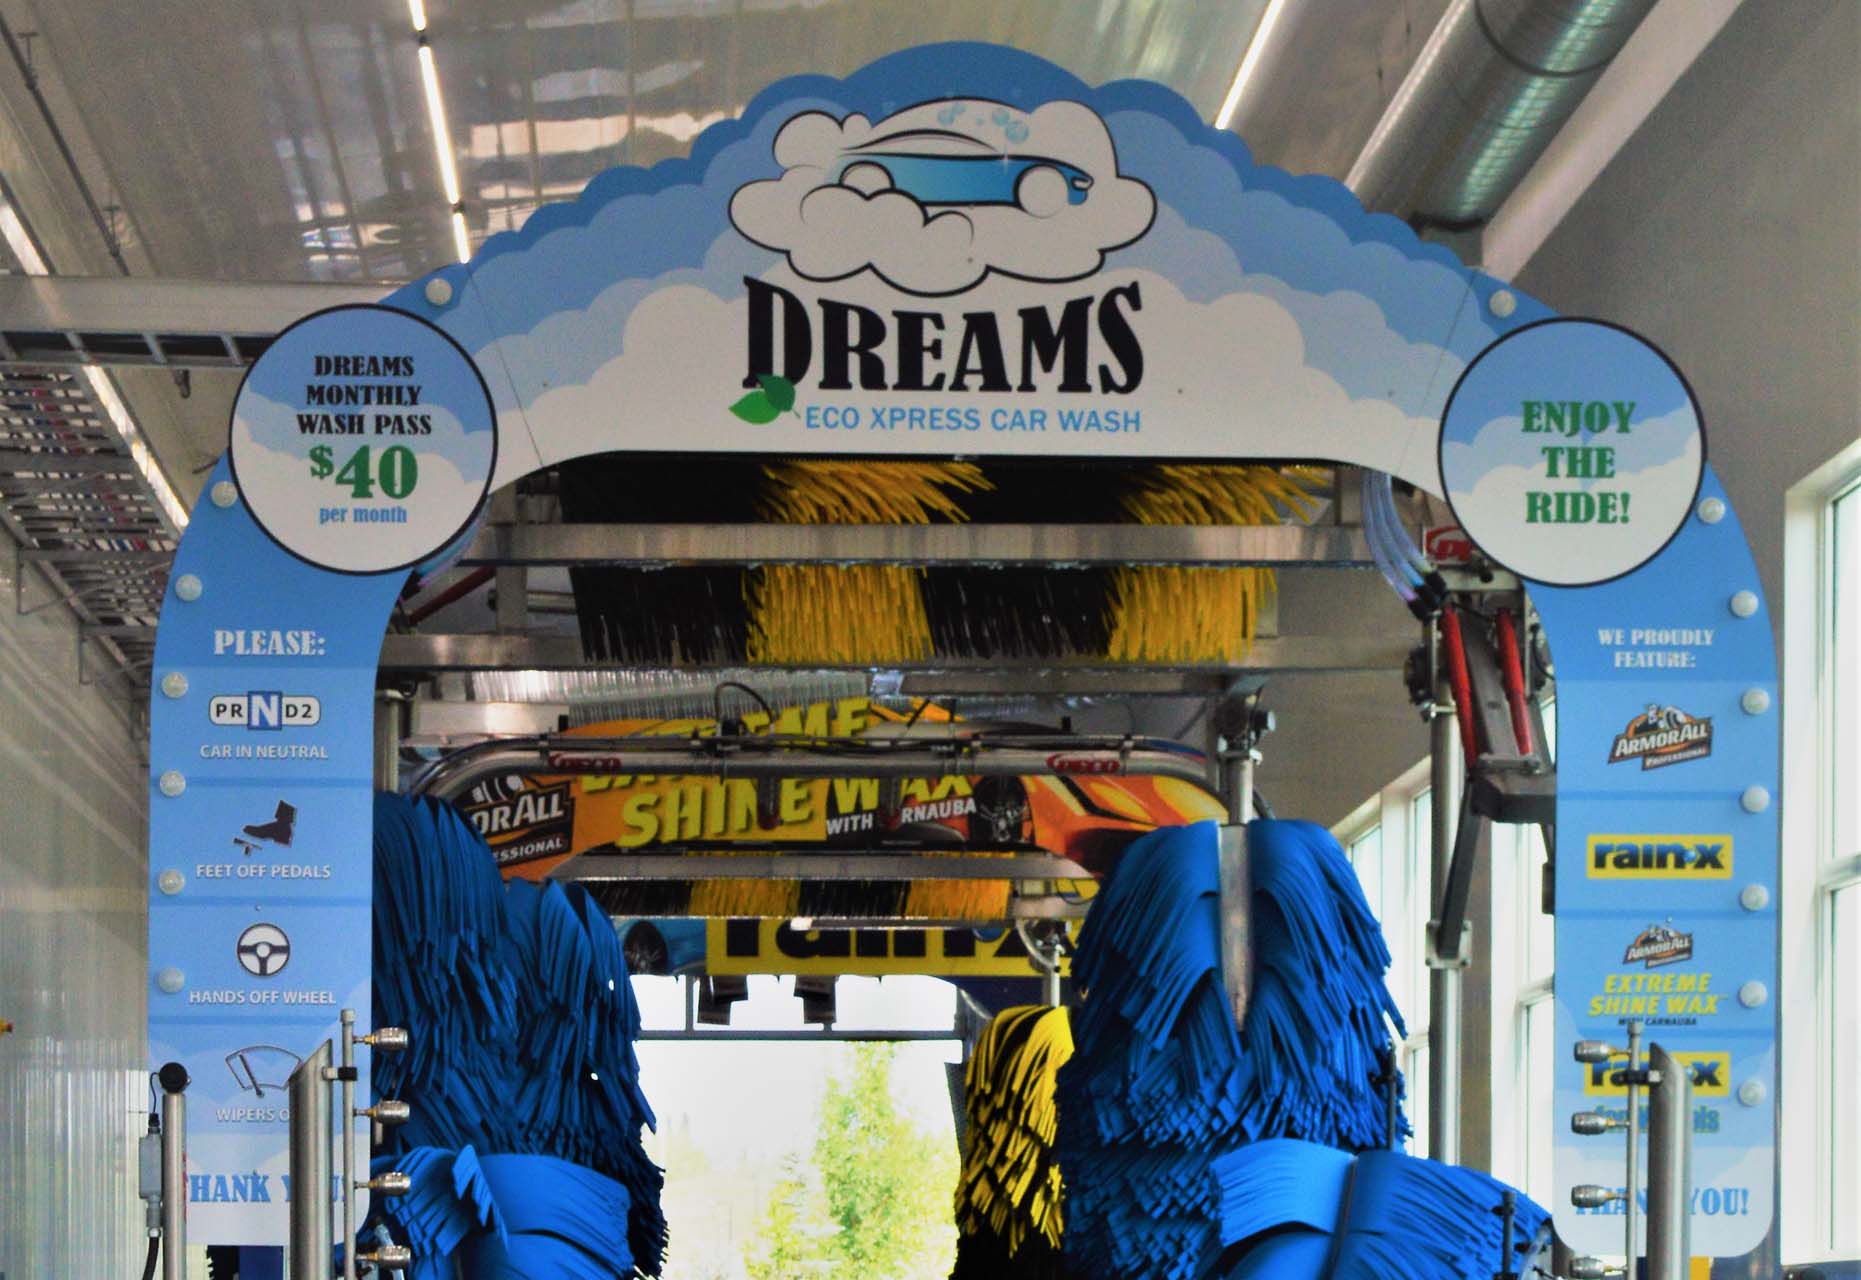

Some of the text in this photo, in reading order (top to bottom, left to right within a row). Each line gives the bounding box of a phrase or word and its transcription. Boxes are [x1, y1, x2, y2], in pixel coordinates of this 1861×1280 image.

[742, 275, 1144, 395] DREAMS
[314, 355, 415, 377] DREAMS
[306, 384, 423, 406] MONTHLY
[297, 414, 433, 435] WASH PASS
[805, 406, 1141, 433] ECO XPRESS CAR WASH
[1521, 401, 1636, 437] ENJOY
[309, 444, 418, 500] $40
[1541, 446, 1616, 478] THE
[319, 506, 408, 525] per month
[1525, 491, 1631, 524] RIDE!
[213, 630, 326, 656] PLEASE:
[1597, 629, 1715, 647] WE PROUDLY
[1614, 651, 1697, 668] FEATURE:
[200, 744, 329, 760] CAR IN NEUTRAL
[472, 793, 566, 834] ORALL
[826, 797, 977, 835] WITH RNAUBA
[493, 838, 563, 861] SSIONAL
[196, 864, 332, 880] FEET OFF PEDALS
[1604, 972, 1713, 994] EXTREME
[189, 990, 337, 1005] HANDS OFF WHEEL
[1588, 994, 1719, 1017] SHINE WAX
[216, 1107, 275, 1123] WIPERS
[189, 1174, 272, 1202] HANK
